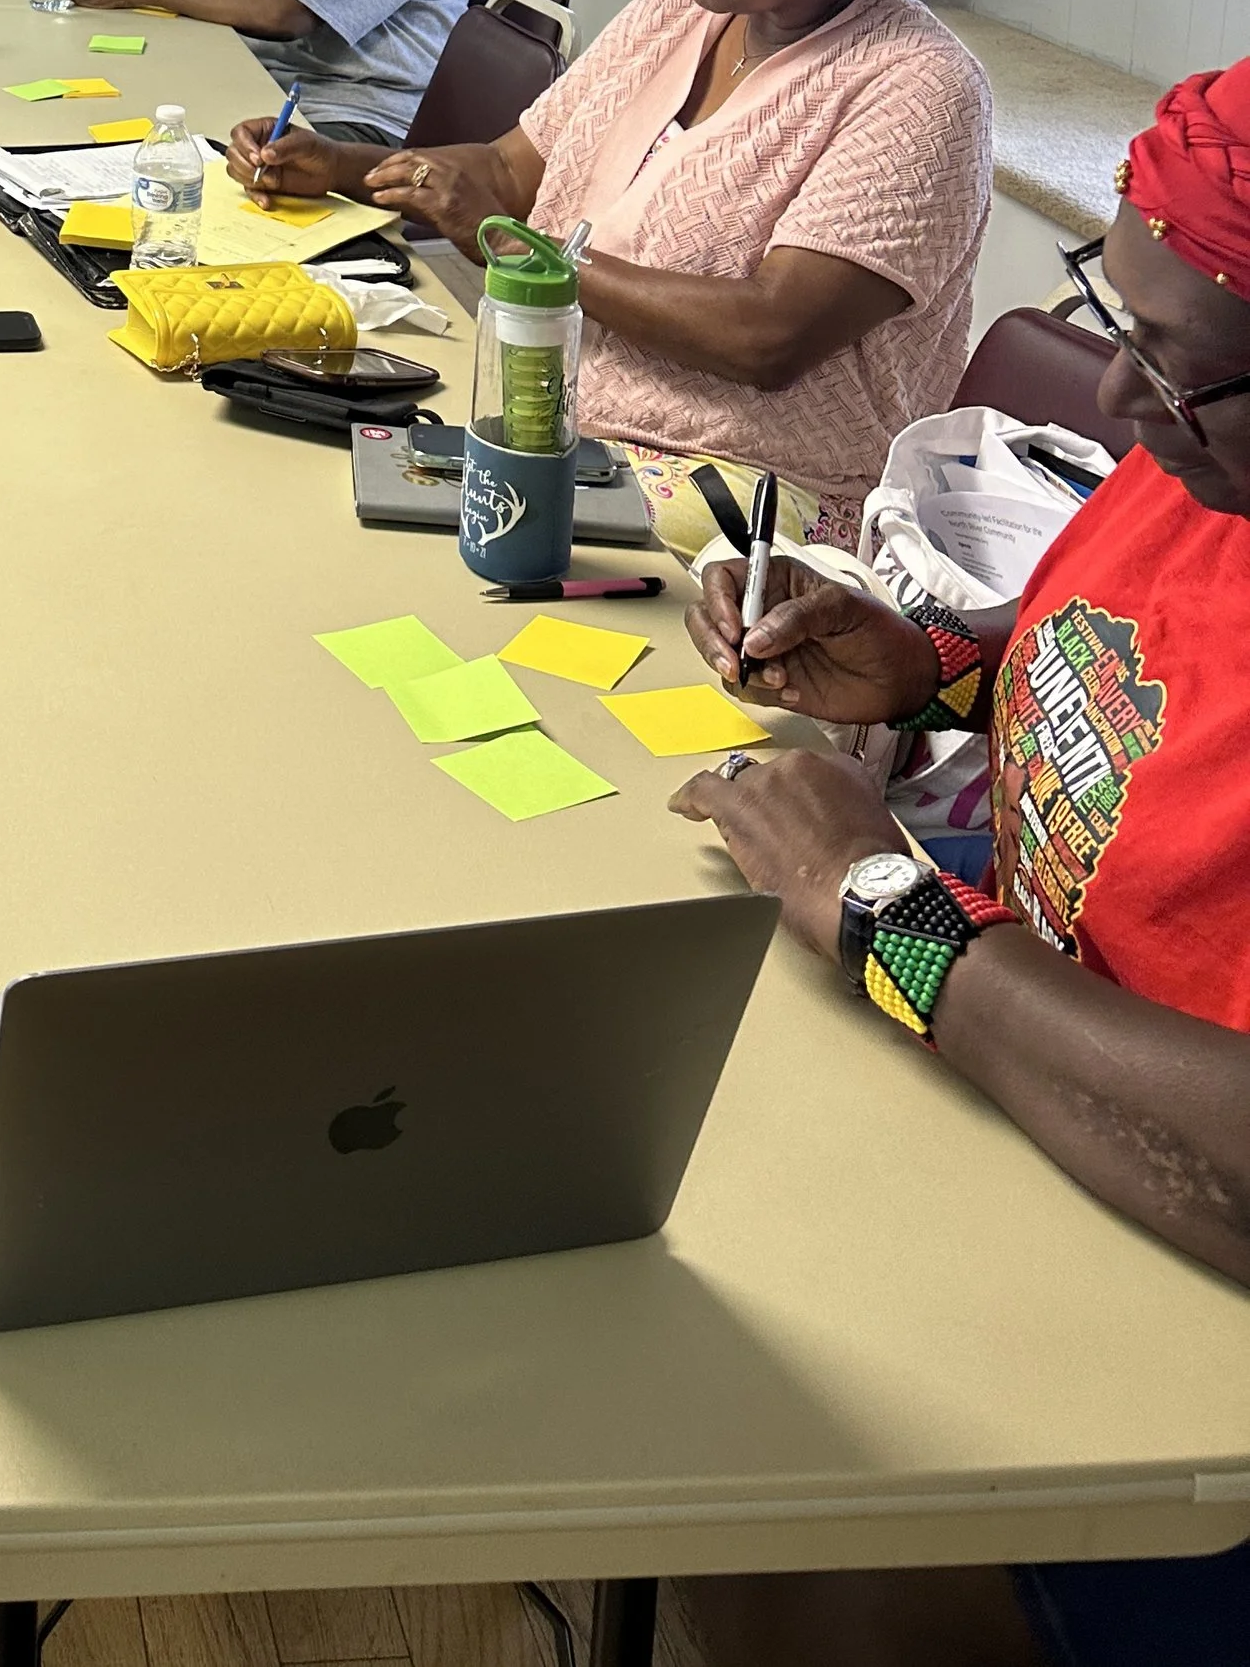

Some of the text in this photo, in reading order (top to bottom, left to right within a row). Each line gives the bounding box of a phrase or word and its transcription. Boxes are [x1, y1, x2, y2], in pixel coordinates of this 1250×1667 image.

[477, 469, 498, 488] the
[1055, 619, 1094, 672] BLACK
[1070, 609, 1107, 661] FESTIVAL
[1074, 774, 1114, 814] TEXAS
[1096, 785, 1121, 815] 1865
[1045, 794, 1071, 835] 19
[1058, 809, 1098, 865] FREE
